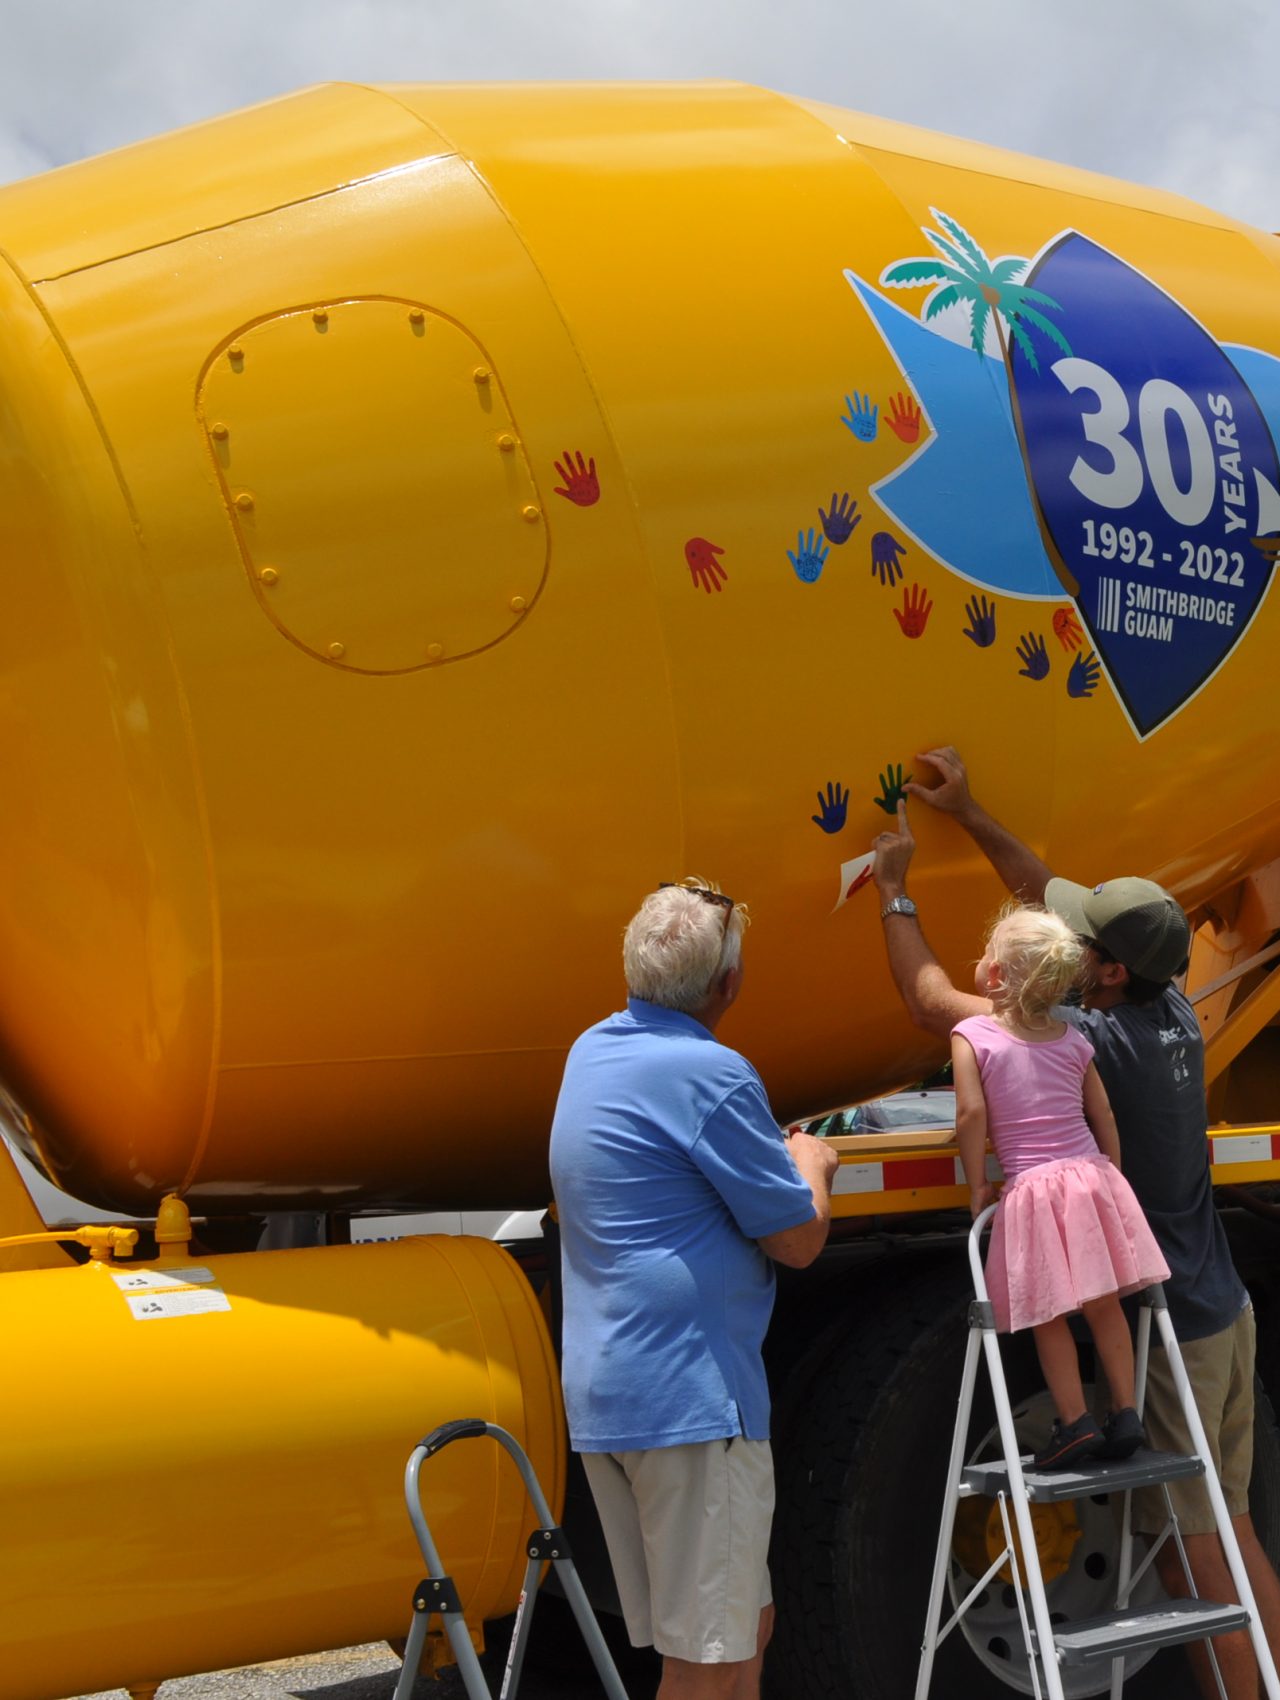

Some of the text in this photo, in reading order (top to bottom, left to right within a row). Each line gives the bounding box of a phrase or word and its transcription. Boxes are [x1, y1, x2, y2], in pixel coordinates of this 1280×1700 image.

[1050, 357, 1216, 526] 30
[1207, 392, 1247, 535] YEARS
[1081, 519, 1154, 568] 1992
[1179, 540, 1246, 588] 2022
[1124, 610, 1174, 642] GUAM
[1125, 581, 1236, 627] SMITHBRIDGE
